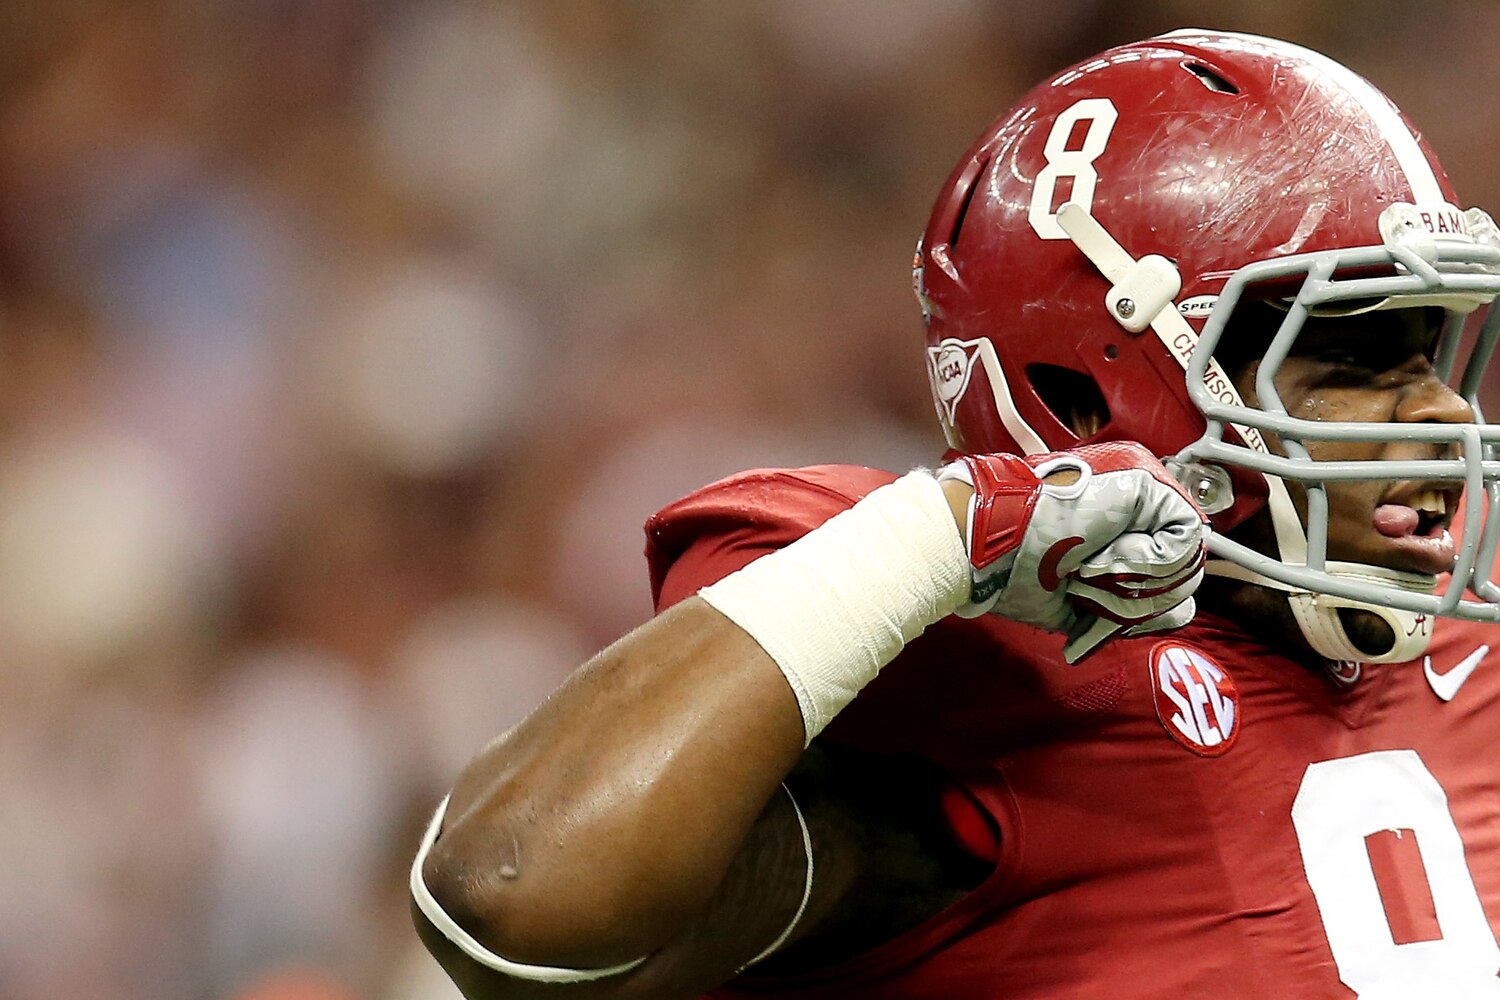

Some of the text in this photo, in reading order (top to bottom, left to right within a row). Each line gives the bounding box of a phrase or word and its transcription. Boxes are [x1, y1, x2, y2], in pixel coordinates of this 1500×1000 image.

[1028, 98, 1119, 239] 8
[1180, 301, 1217, 313] SPEE
[1158, 646, 1235, 747] SEC
